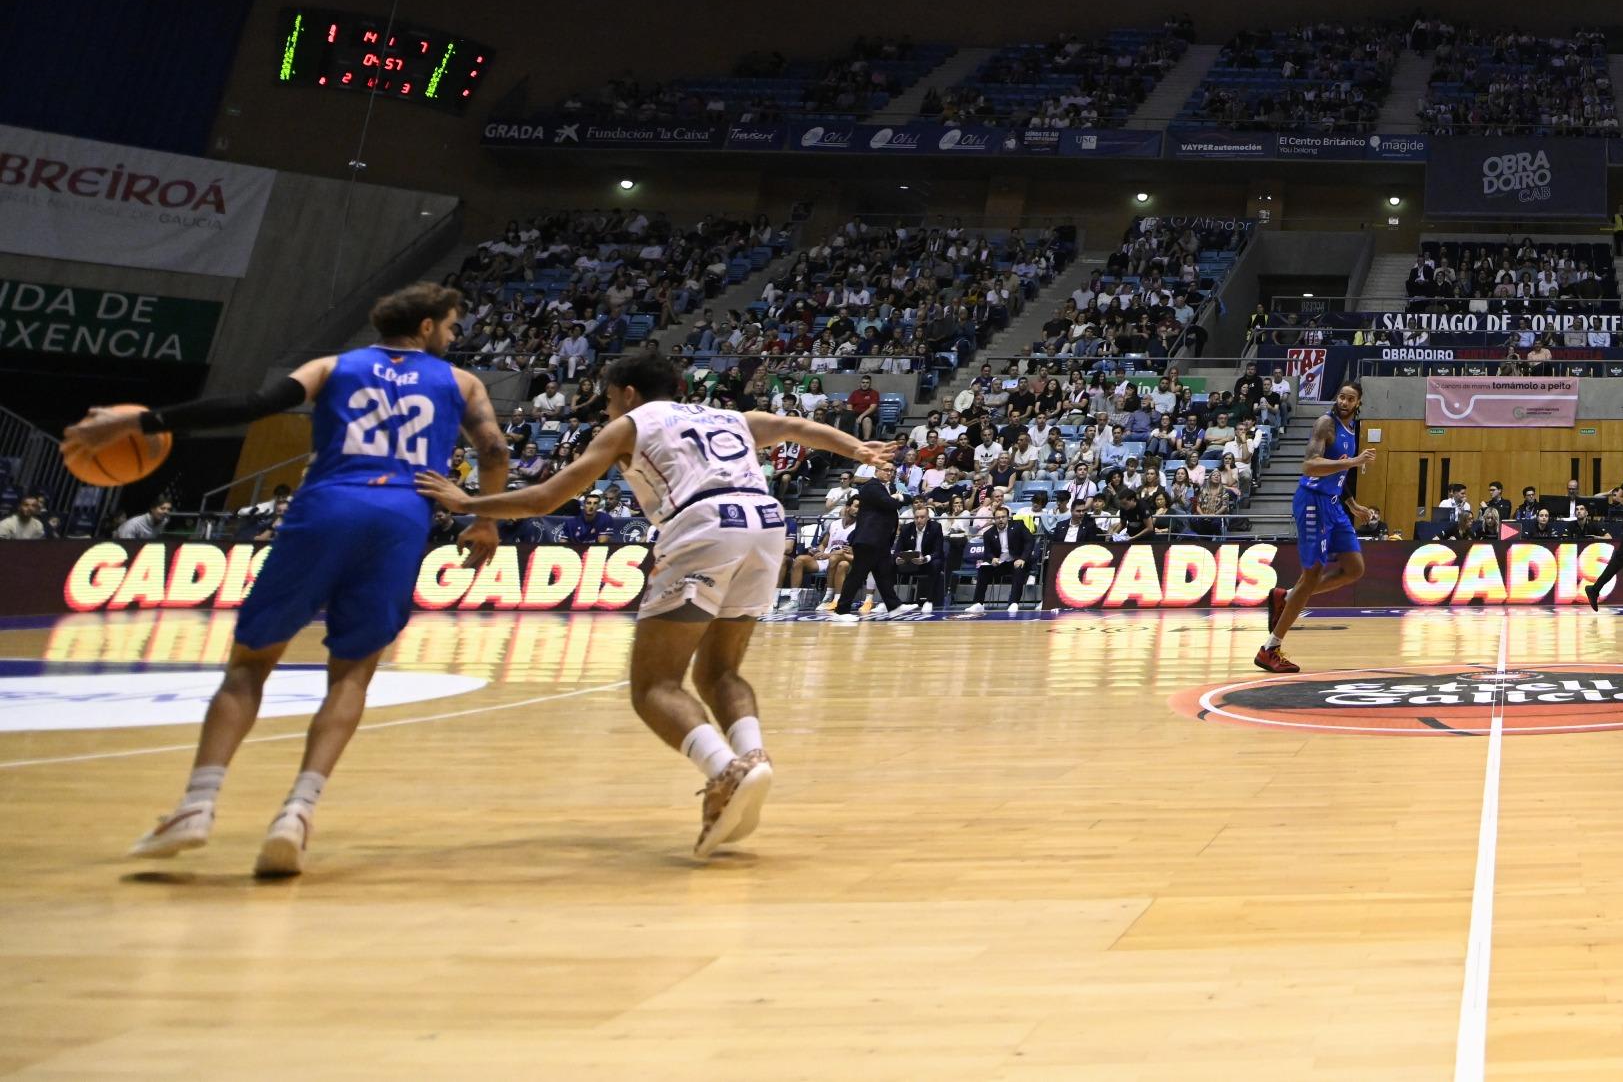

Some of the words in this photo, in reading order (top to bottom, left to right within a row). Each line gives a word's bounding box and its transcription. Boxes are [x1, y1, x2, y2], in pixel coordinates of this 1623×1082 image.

[484, 122, 545, 140] GRADA
[586, 126, 653, 141] Fundación
[1279, 137, 1288, 146] El
[1288, 137, 1322, 146] Centro
[1323, 136, 1365, 147] Británico
[1382, 141, 1424, 153] magide
[1482, 149, 1551, 177] OBRA
[1482, 168, 1551, 194] DOIRO
[1518, 187, 1551, 203] CAB
[96, 292, 159, 323] DE
[1382, 313, 1478, 335] SANTIAGO
[1486, 314, 1512, 334] DE
[0, 319, 183, 361] XENCIA
[1382, 348, 1454, 360] OBRADOIRO
[1493, 381, 1539, 390] tomámolo
[1548, 381, 1572, 392] peito
[342, 386, 435, 466] 22
[680, 428, 749, 461] 10
[413, 544, 649, 611] GADIS
[1055, 544, 1278, 608] GADIS
[1402, 543, 1616, 605] GADIS
